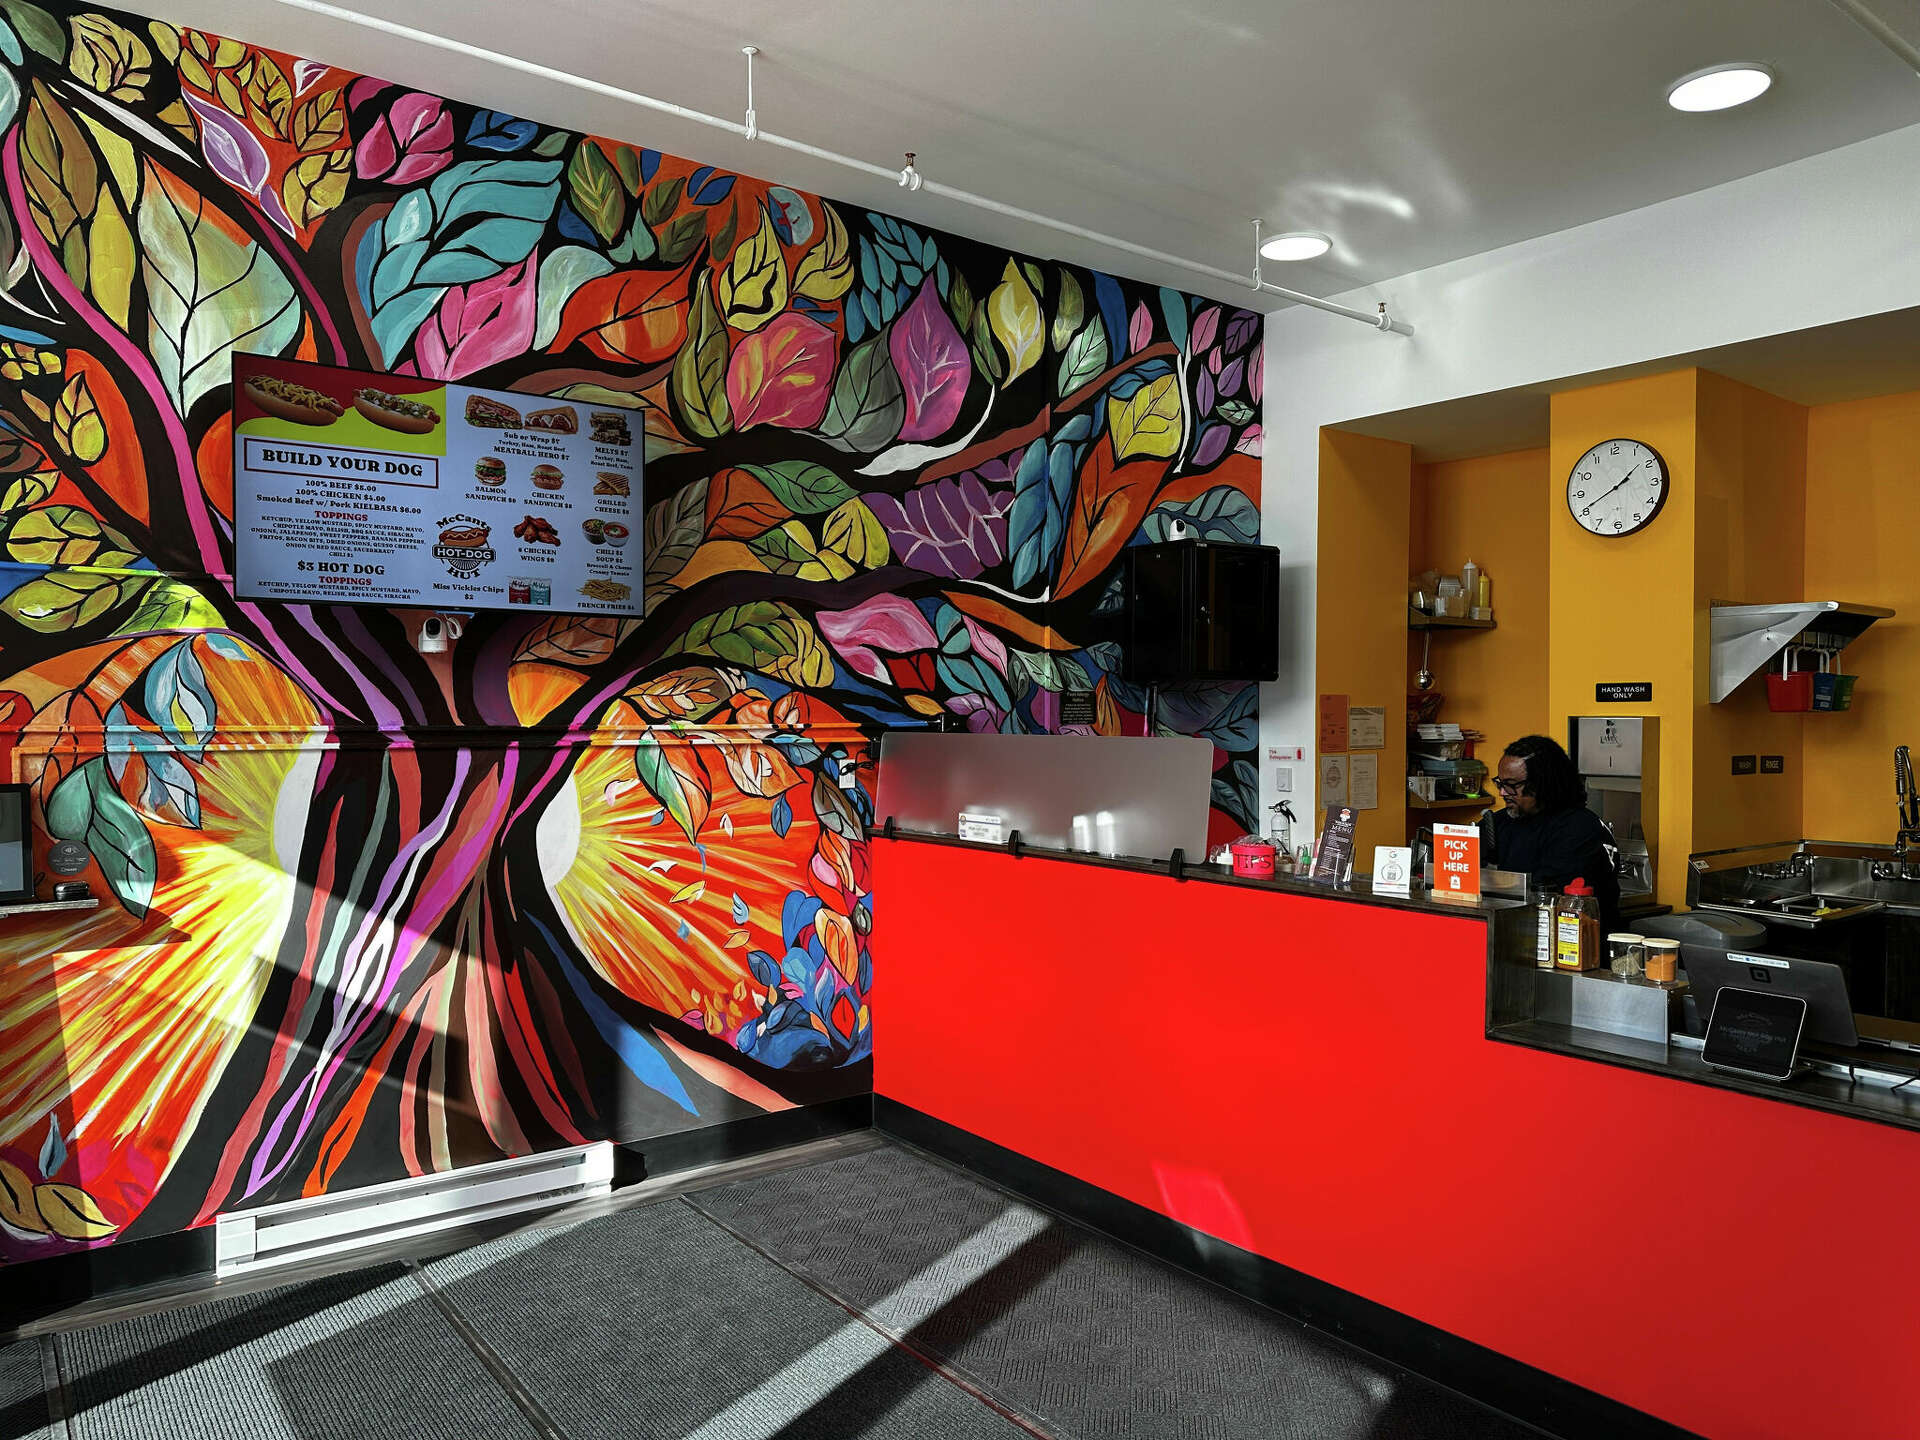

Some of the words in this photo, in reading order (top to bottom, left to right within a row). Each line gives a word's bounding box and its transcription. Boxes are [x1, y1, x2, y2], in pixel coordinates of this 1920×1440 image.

[530, 435, 550, 444] Wrap
[494, 446, 536, 456] MEATBALL
[538, 451, 560, 460] HERO
[594, 446, 619, 456] MELTS
[1610, 446, 1620, 455] 12
[262, 449, 322, 466] BUILD
[327, 456, 380, 472] YOUR
[384, 462, 423, 476] DOG
[1646, 460, 1653, 468] 2
[1580, 472, 1592, 480] 10
[330, 482, 353, 490] BEEF
[1650, 478, 1659, 486] 3
[475, 486, 506, 494] SALMON
[320, 490, 362, 500] CHICKEN
[465, 493, 506, 502] SANDWICH
[532, 492, 565, 500] CHICKEN
[256, 494, 292, 504] Smoked
[353, 502, 398, 512] KIELBASA
[524, 499, 564, 508] SANDWICH
[598, 499, 627, 507] GRILLED
[314, 510, 368, 521] TOPPINGS
[1582, 508, 1590, 516] 8
[1633, 513, 1641, 521] 5
[1614, 521, 1622, 529] 6
[437, 548, 492, 560] HOT-DOG
[298, 560, 314, 571] $3
[318, 562, 349, 573] HOT
[353, 564, 385, 575] DOG
[447, 566, 480, 580] HUT
[319, 576, 372, 586] TOPPINGS
[1444, 840, 1468, 850] PICK
[1449, 851, 1464, 860] UP
[1443, 861, 1470, 873] HERE
